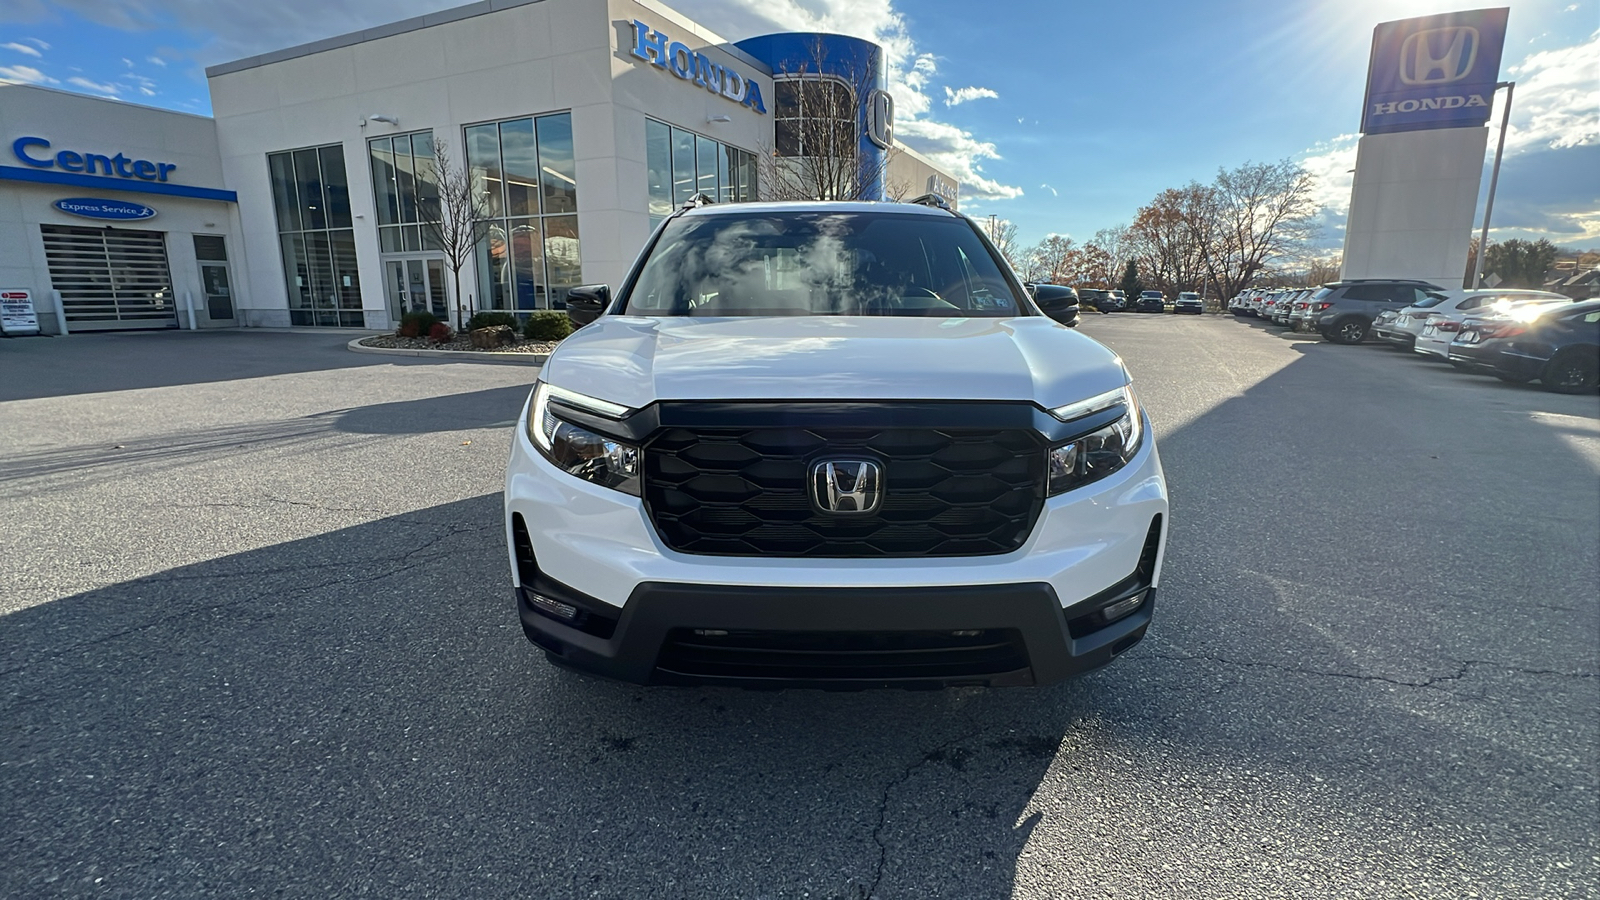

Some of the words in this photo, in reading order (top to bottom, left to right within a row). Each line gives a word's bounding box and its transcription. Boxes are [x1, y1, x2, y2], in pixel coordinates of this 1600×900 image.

[631, 19, 767, 114] HONDA
[1373, 94, 1487, 115] HONDA
[13, 136, 177, 182] Center
[61, 202, 100, 212] Express
[101, 205, 137, 215] Service
